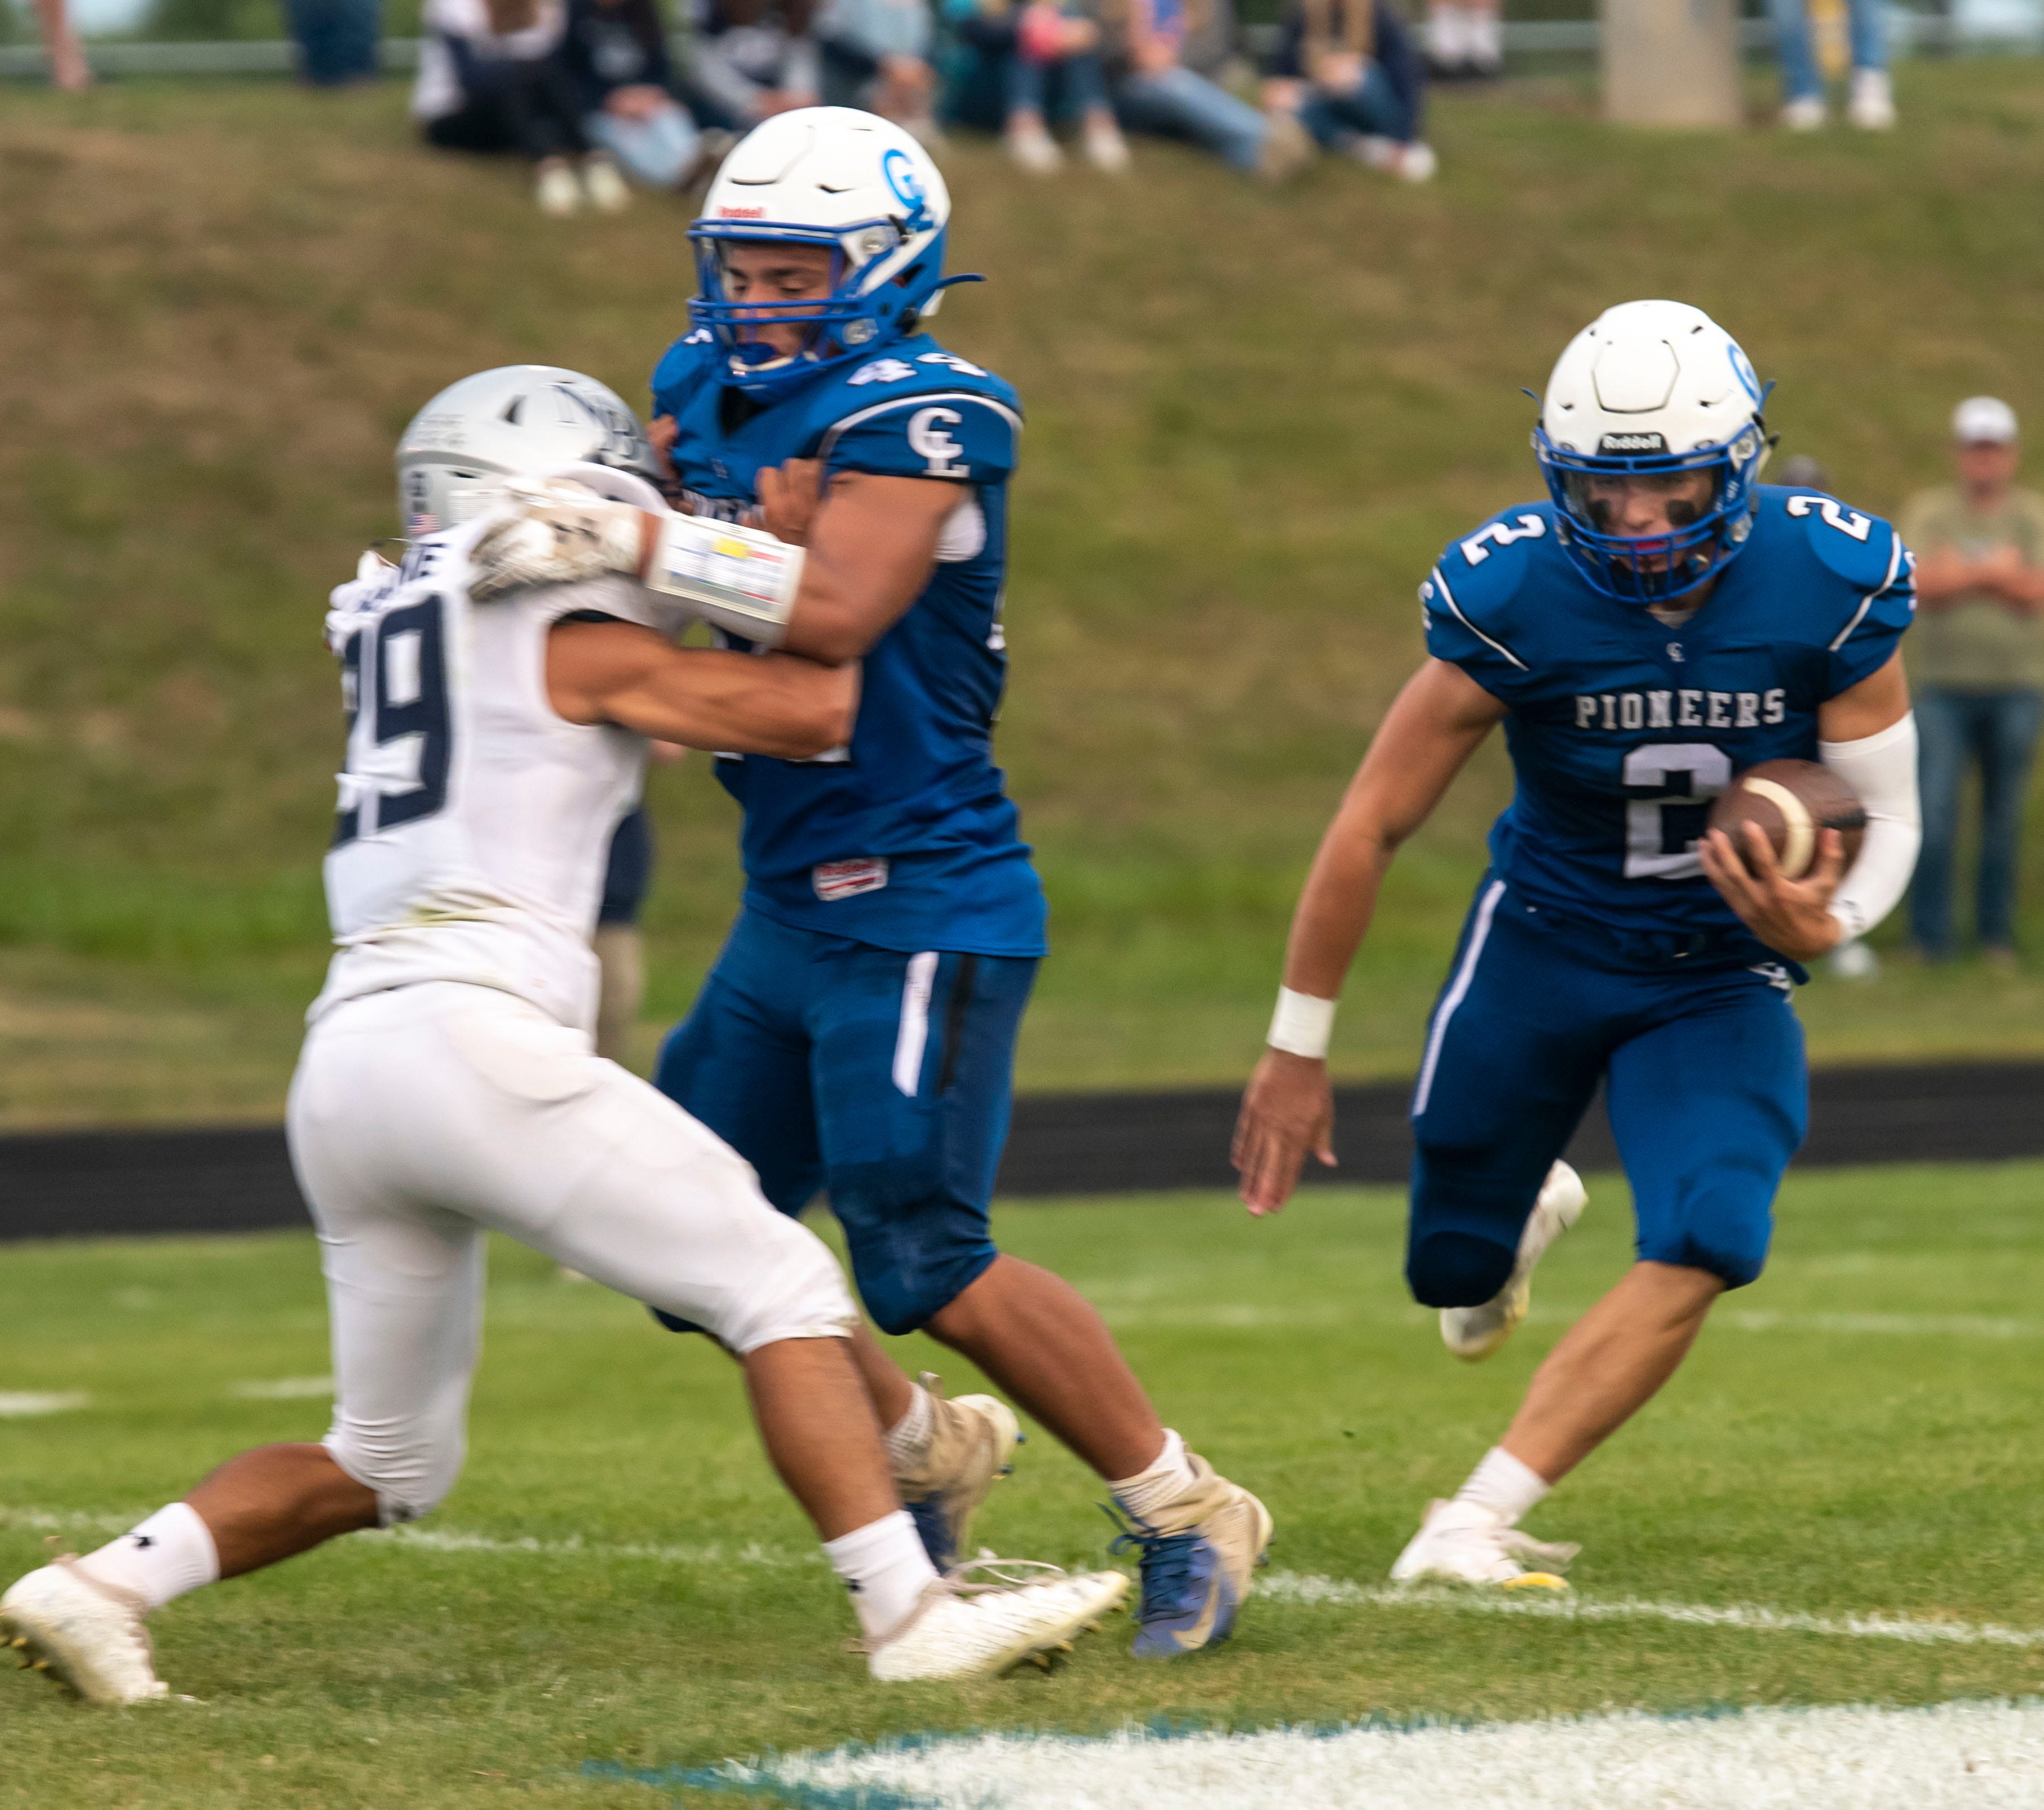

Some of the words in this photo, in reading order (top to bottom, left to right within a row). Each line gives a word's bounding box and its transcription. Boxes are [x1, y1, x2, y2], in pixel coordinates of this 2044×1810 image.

[1602, 434, 1661, 449] Riddell
[1459, 514, 1546, 567] 2
[1786, 495, 1872, 542] 2
[1576, 688, 1786, 729] PIONEERS
[1623, 744, 1732, 879] 2
